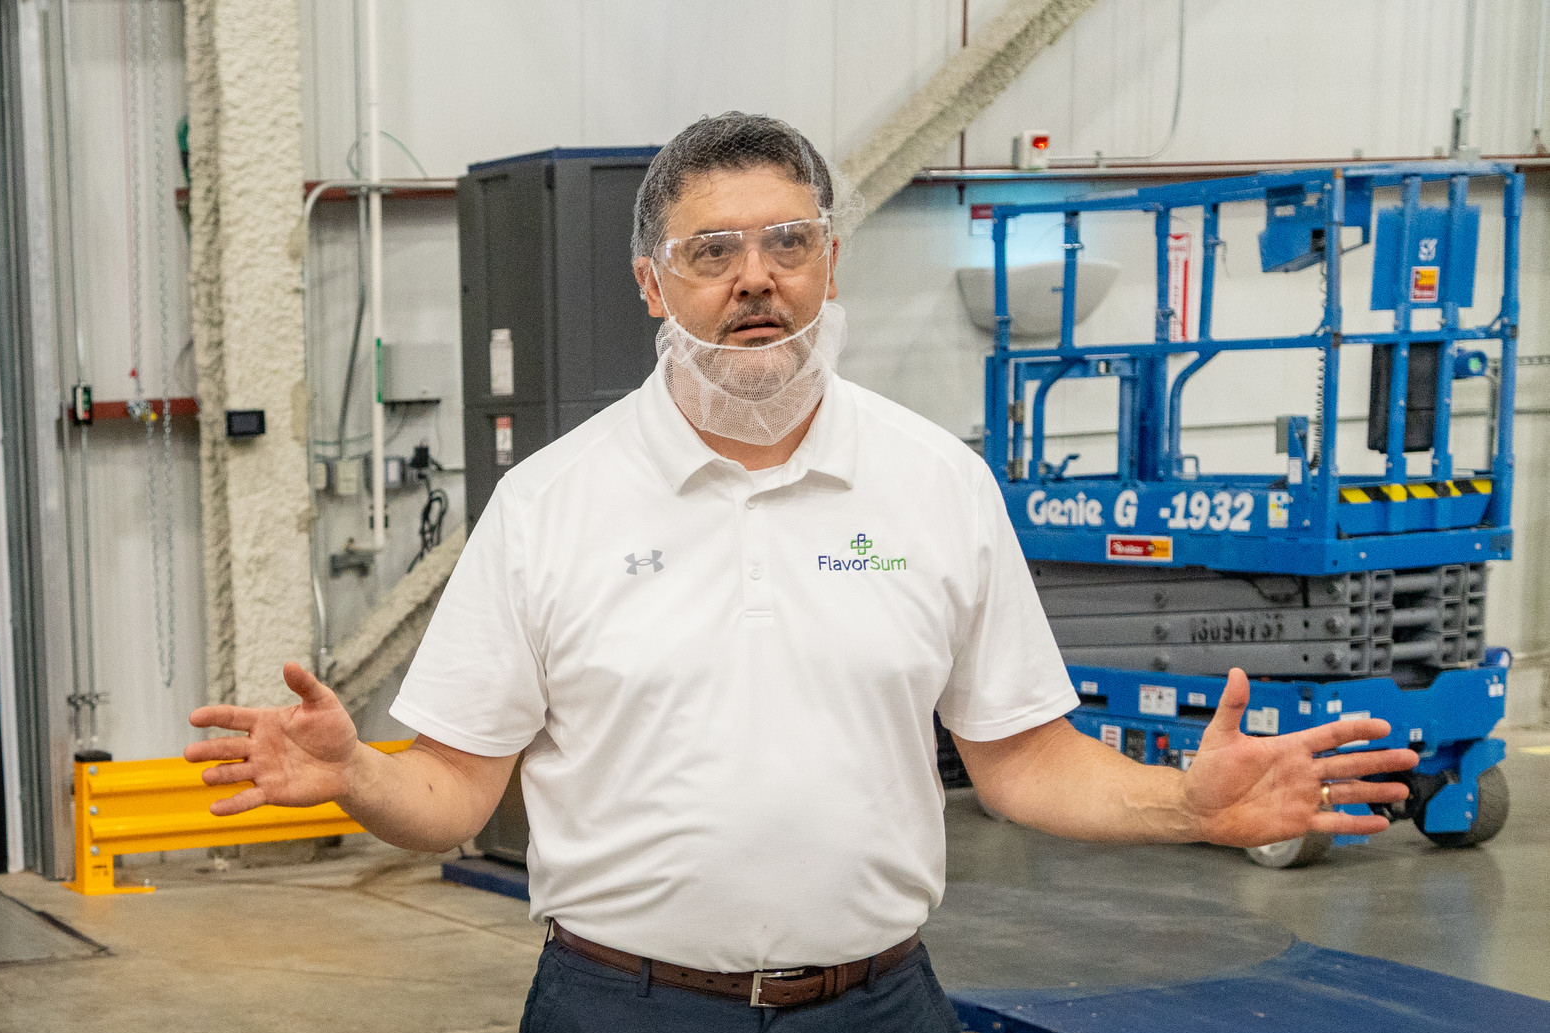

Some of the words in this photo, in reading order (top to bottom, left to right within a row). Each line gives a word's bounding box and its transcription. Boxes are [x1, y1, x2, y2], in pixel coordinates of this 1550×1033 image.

[1026, 490, 1103, 526] Genie
[1114, 489, 1138, 527] G
[1159, 491, 1254, 531] -1932
[818, 555, 907, 571] FlavorSum
